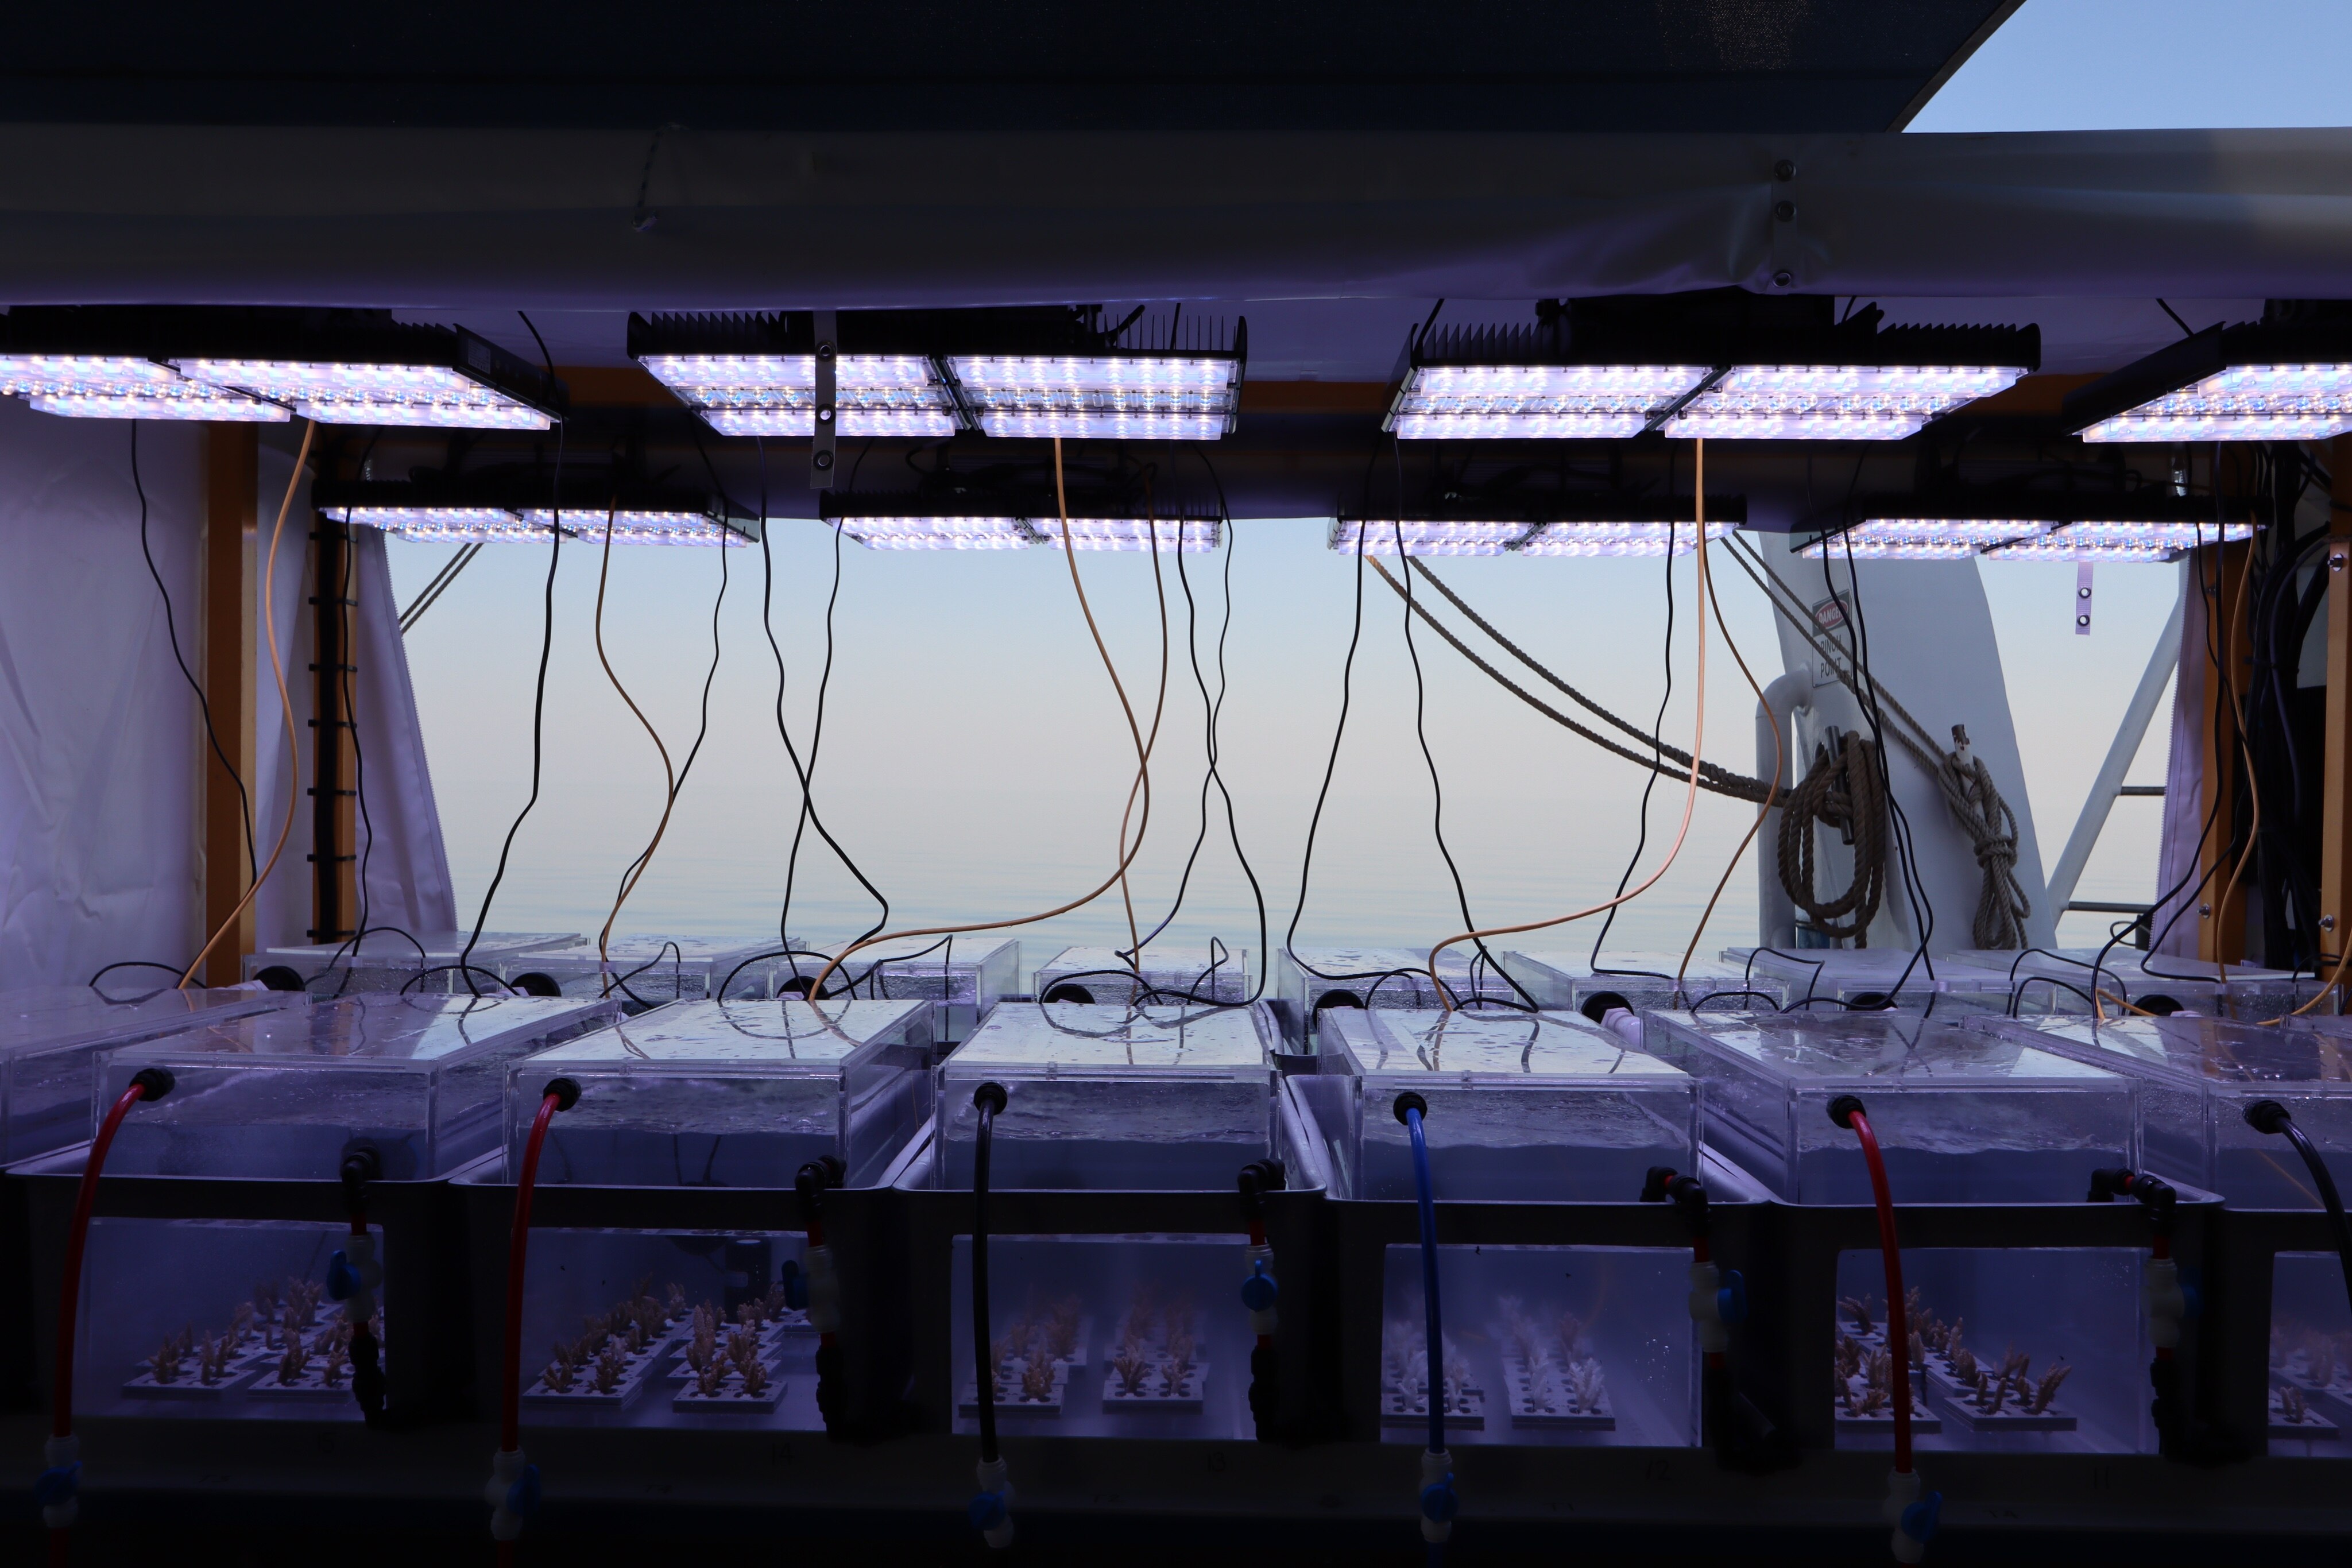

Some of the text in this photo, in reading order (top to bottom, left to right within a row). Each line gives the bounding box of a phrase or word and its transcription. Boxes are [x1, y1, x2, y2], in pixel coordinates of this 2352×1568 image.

[317, 1431, 338, 1454] 15
[771, 1442, 795, 1466] 14
[1206, 1451, 1227, 1472] 13
[1645, 1459, 1672, 1481] 12
